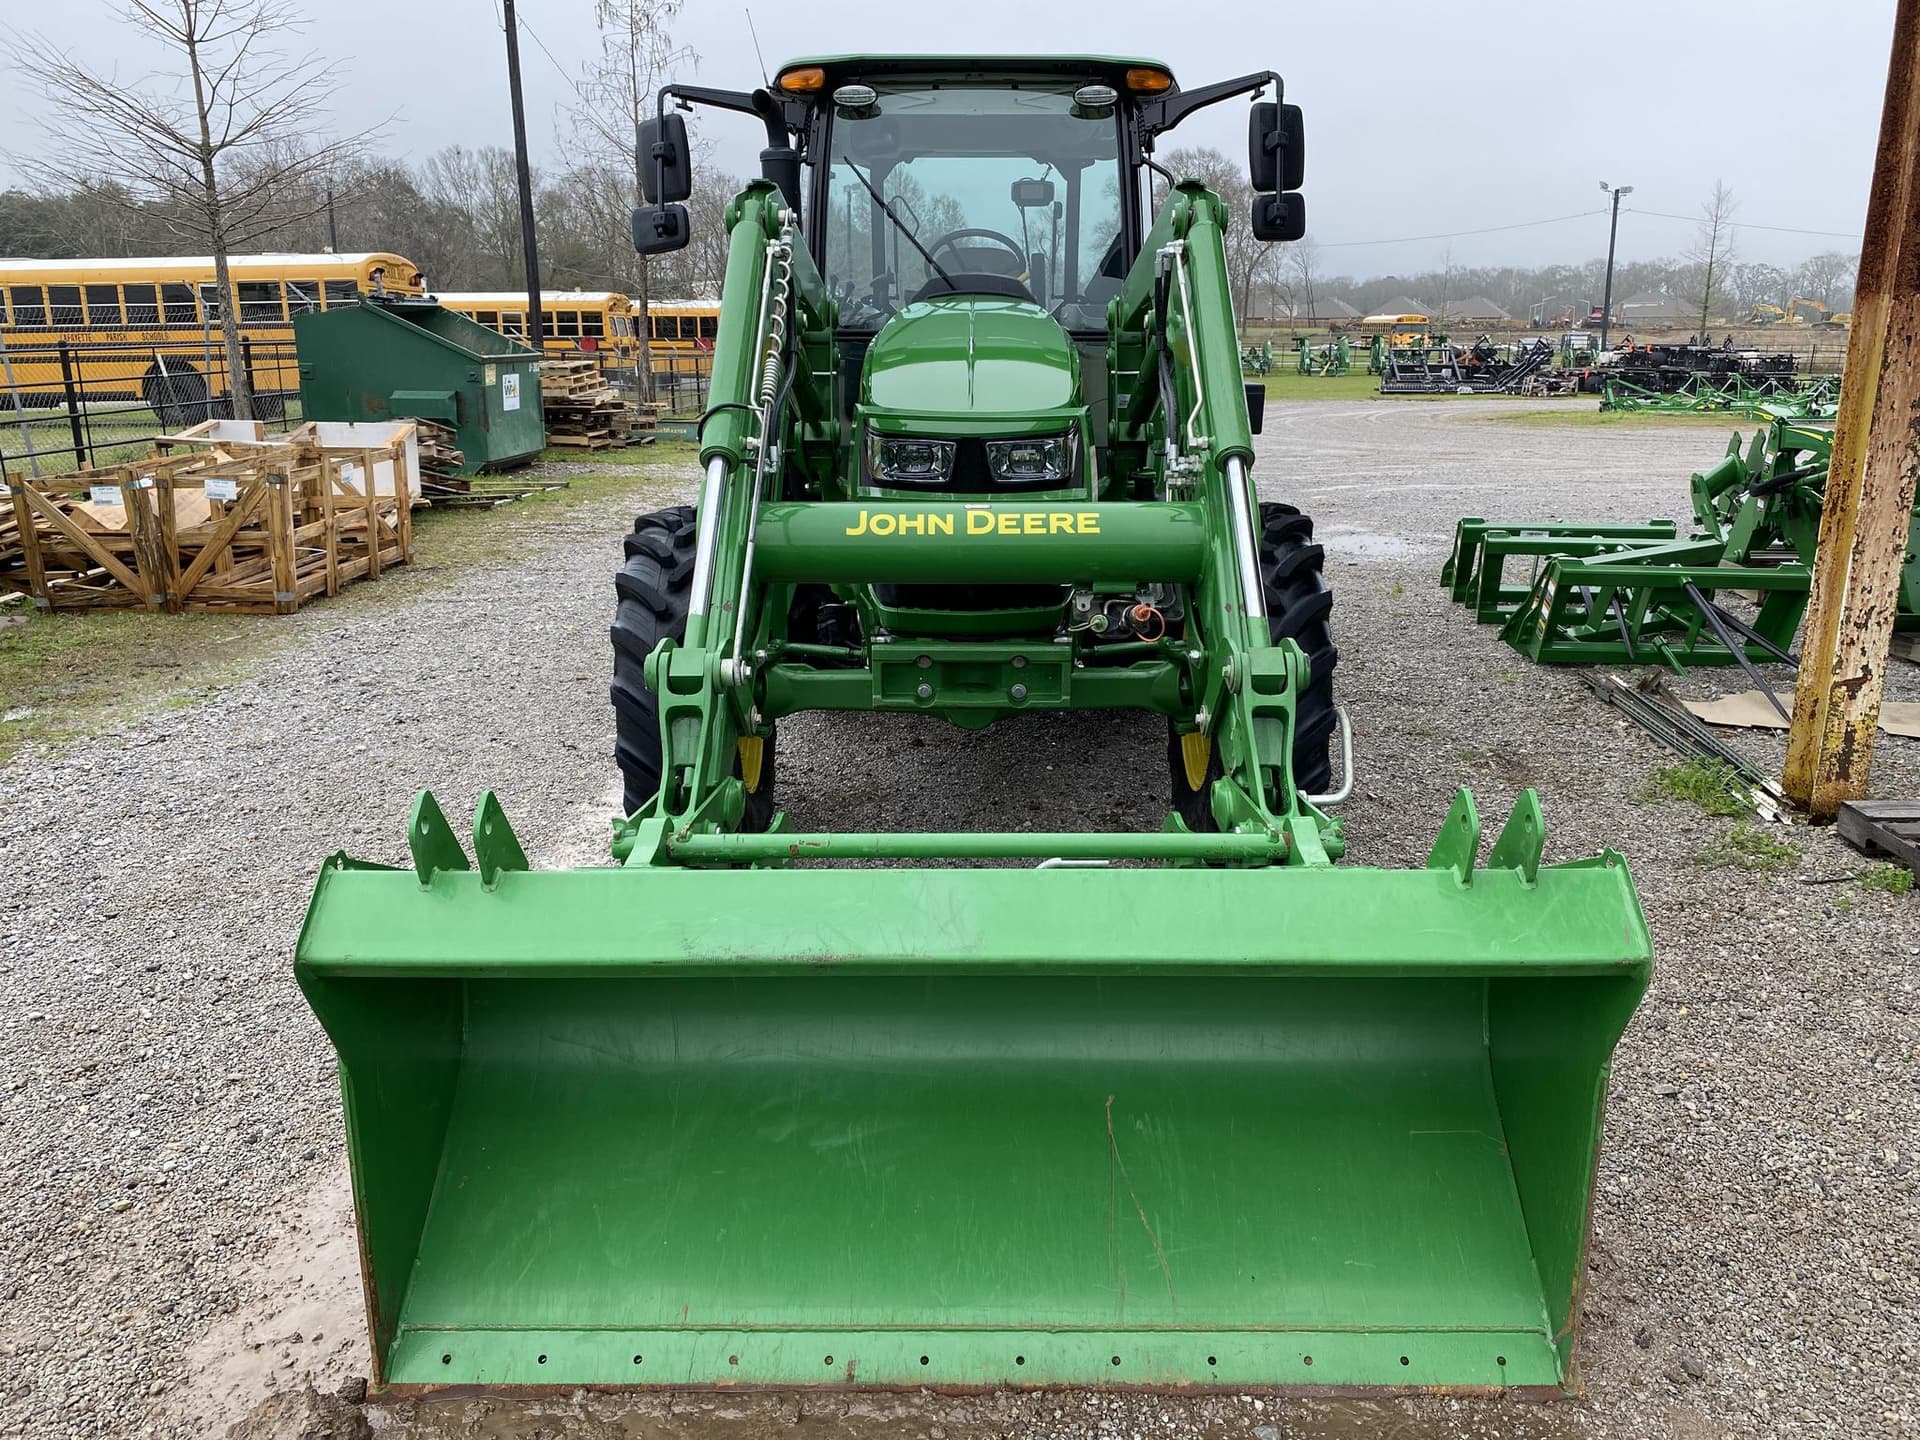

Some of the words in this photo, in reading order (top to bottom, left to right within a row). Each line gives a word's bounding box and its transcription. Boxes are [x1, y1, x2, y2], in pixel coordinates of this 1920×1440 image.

[141, 332, 169, 341] SCHOOLS
[845, 510, 954, 537] JOHN
[966, 510, 1101, 536] DEERE
